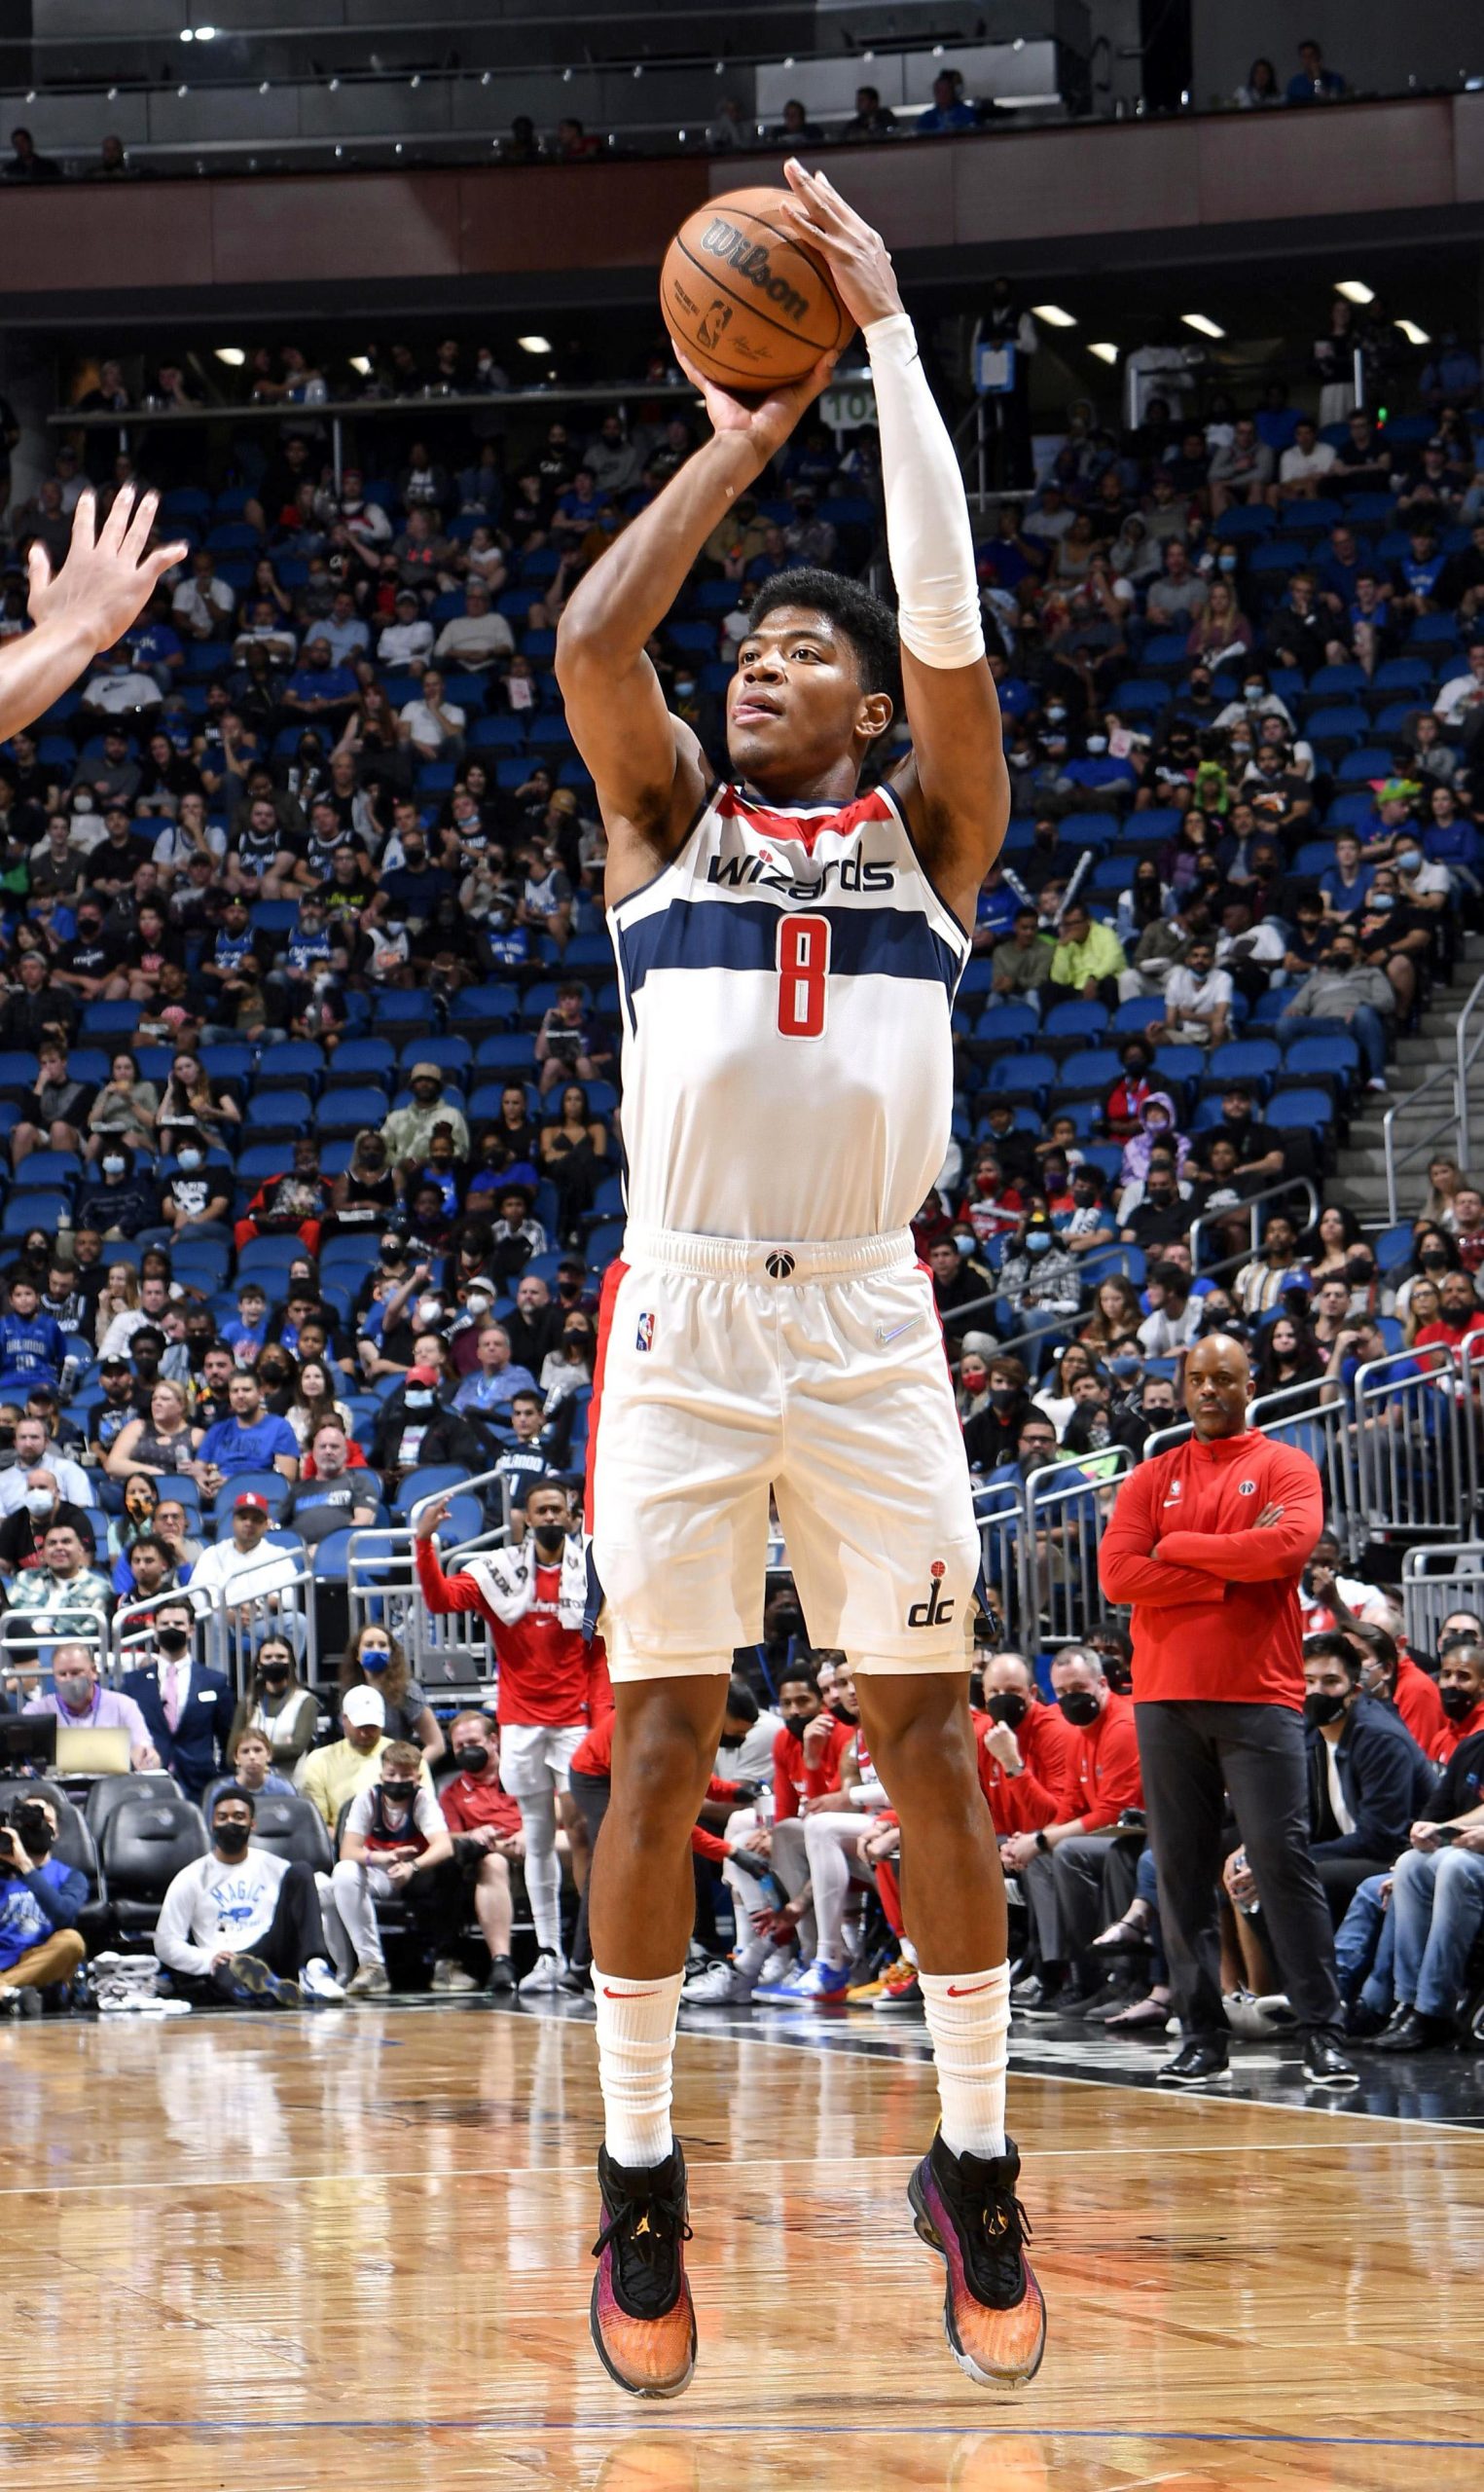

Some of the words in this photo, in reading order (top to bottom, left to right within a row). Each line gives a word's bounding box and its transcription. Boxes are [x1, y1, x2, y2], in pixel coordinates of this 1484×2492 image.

[700, 217, 810, 322] Wilson
[706, 840, 896, 900] wizards
[777, 914, 831, 1041] 8
[908, 1578, 955, 1628] dc
[209, 1880, 266, 1908] MAGIC
